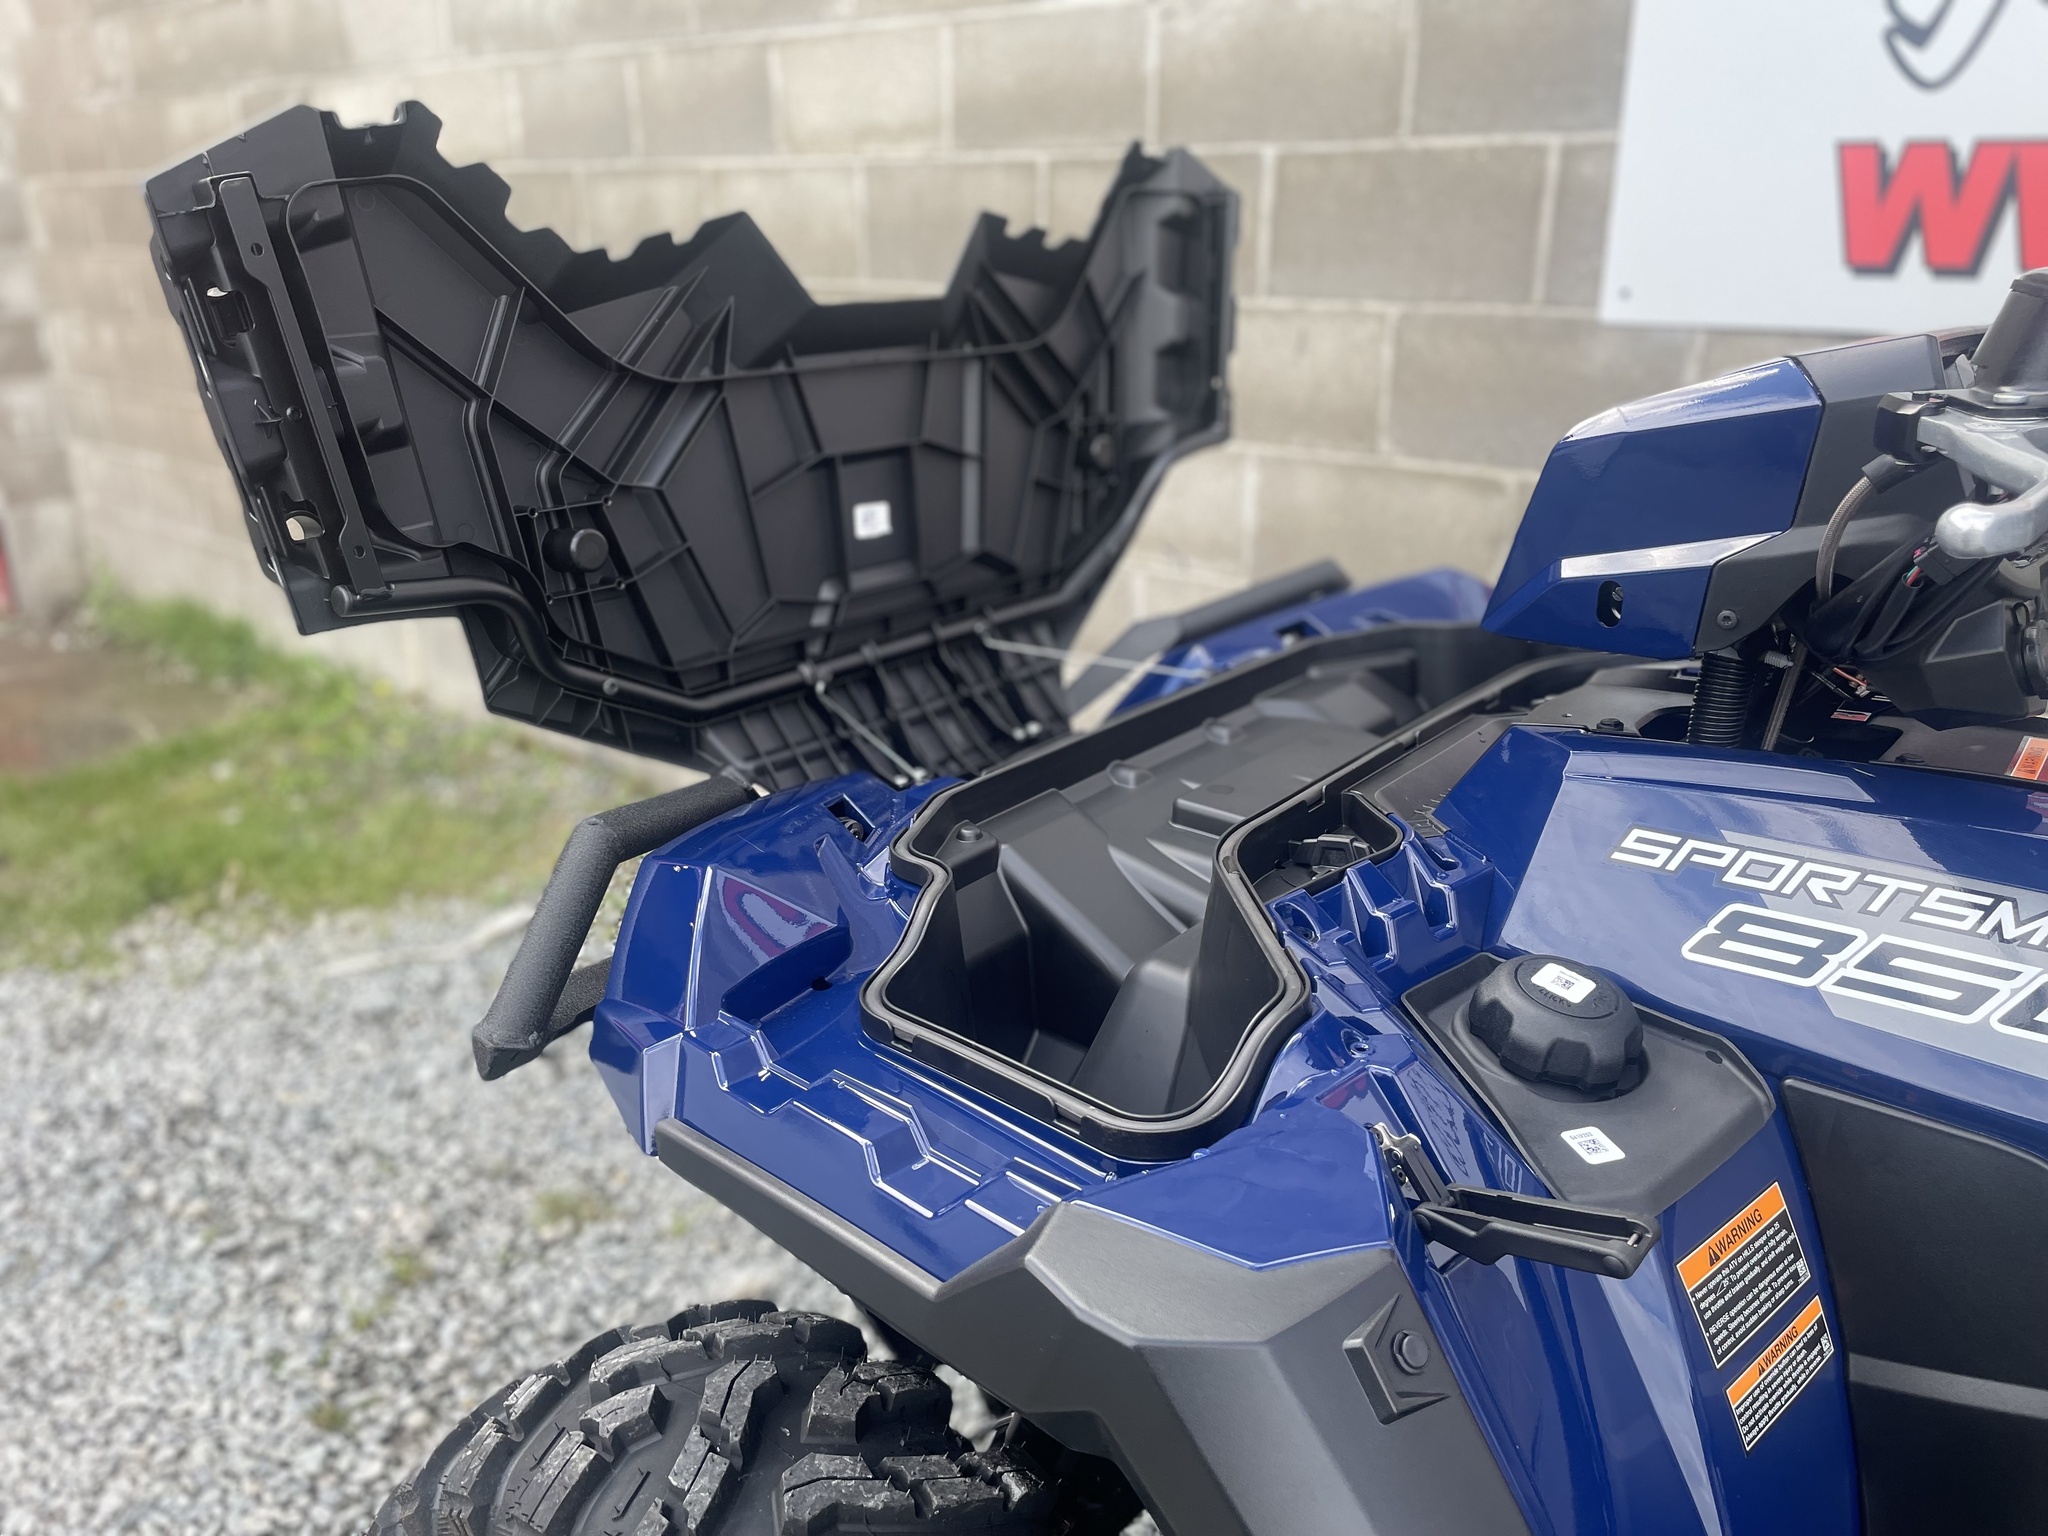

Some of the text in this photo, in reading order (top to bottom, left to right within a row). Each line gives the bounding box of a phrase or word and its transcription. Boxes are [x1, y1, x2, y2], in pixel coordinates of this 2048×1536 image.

[1714, 1208, 1762, 1257] WARNING
[1694, 1285, 1708, 1299] Never
[1707, 1273, 1722, 1289] operate
[1741, 1243, 1754, 1258] HILLS
[1765, 1226, 1775, 1237] than
[1699, 1292, 1716, 1310] degrees
[1735, 1261, 1750, 1279] prevent
[1730, 1279, 1745, 1294] brakes
[1708, 1311, 1730, 1335] REVERSE
[1728, 1297, 1747, 1316] operation
[1727, 1313, 1744, 1331] Steering
[1742, 1298, 1760, 1317] becomes
[1734, 1323, 1746, 1338] avoid
[1744, 1312, 1759, 1328] sudden
[1757, 1300, 1772, 1316] braking
[1762, 1325, 1798, 1367] WARNING
[1735, 1394, 1753, 1415] Improper
